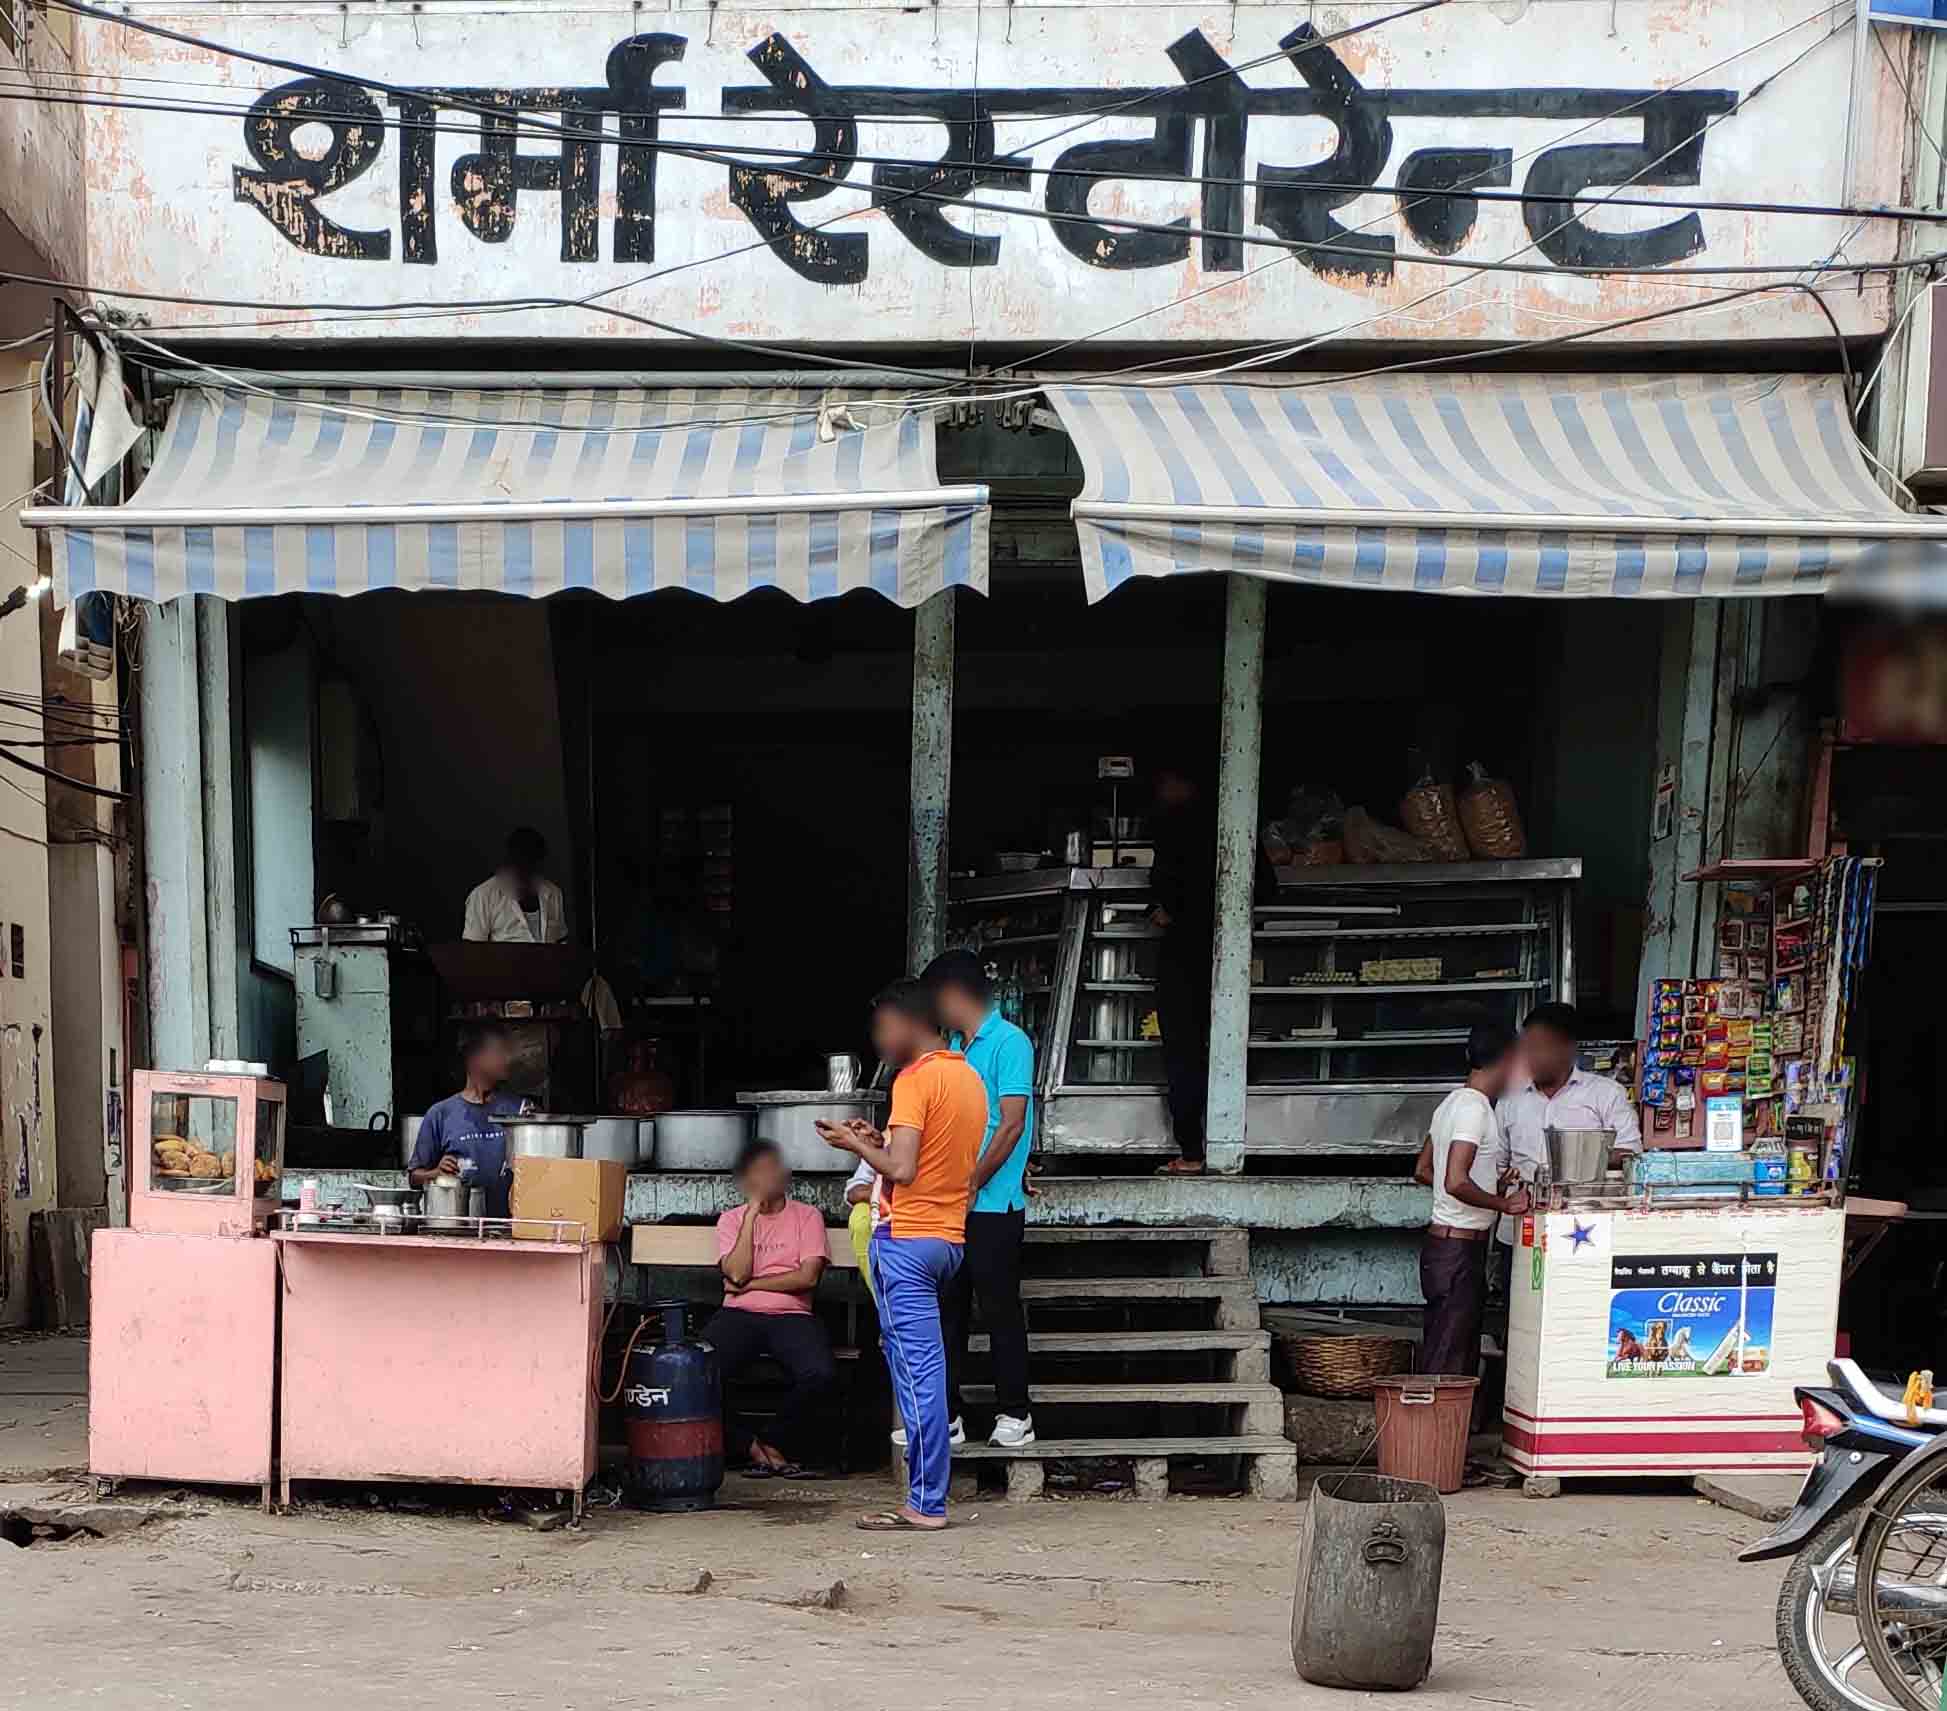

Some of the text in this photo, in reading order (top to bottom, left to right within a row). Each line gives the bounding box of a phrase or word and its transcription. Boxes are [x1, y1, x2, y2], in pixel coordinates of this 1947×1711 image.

[233, 20, 1738, 286] शर्मा रेस्टोरेन्ट
[1657, 1291, 1727, 1313] Classic
[624, 1383, 671, 1407] ण्डेन
